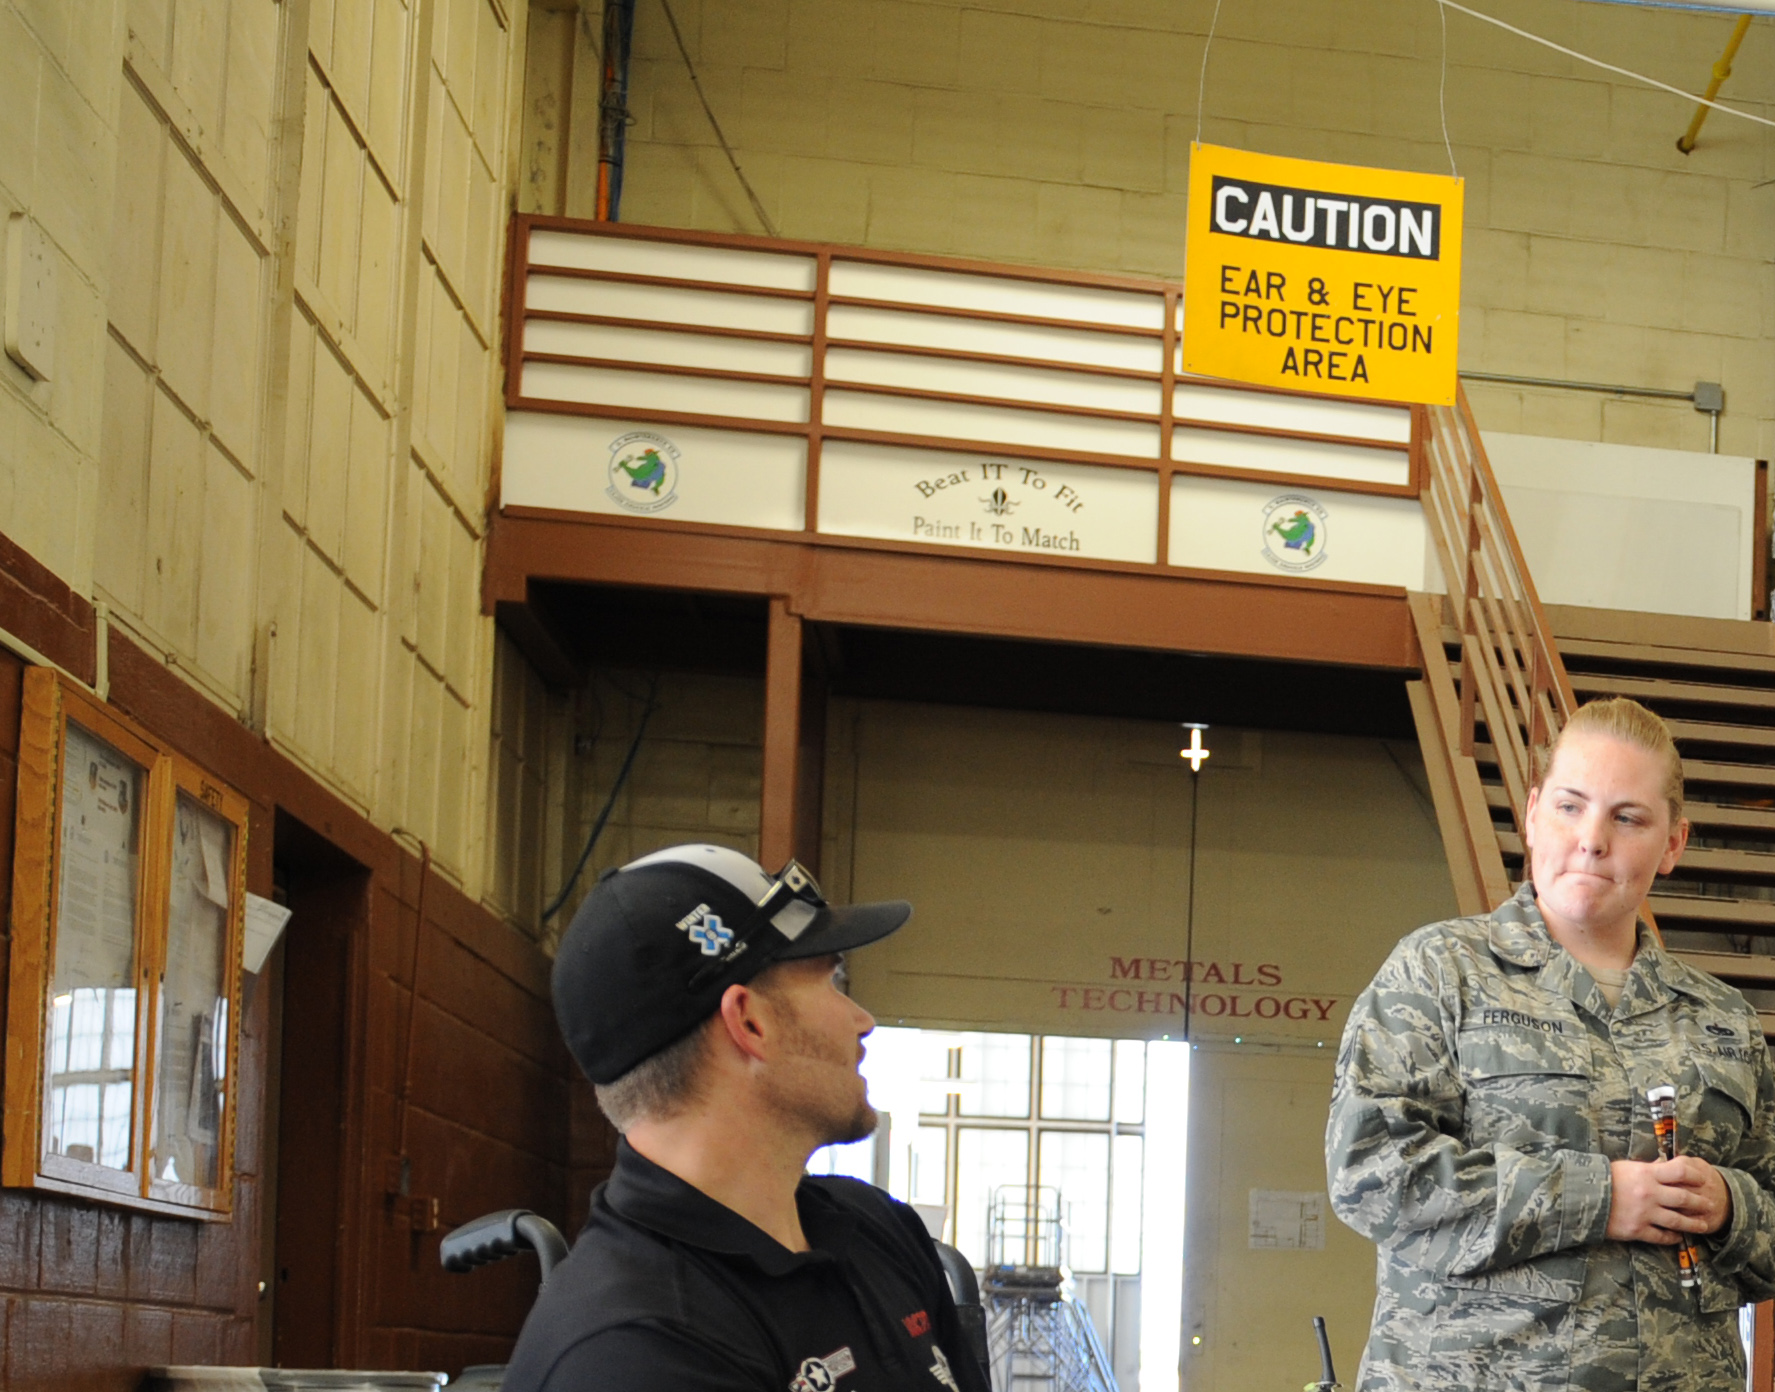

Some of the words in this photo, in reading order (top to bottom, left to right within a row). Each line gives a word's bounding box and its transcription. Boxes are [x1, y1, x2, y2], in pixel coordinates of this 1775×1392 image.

[1215, 185, 1433, 256] CAUTION
[1220, 265, 1286, 302] EAR
[1307, 277, 1330, 306] &
[1353, 282, 1418, 317] EYE
[1219, 300, 1433, 354] PROTECTION
[1280, 346, 1369, 384] AREA
[914, 469, 970, 499] Beat
[980, 463, 1009, 480] IT
[1019, 467, 1047, 490] To
[1053, 484, 1085, 514] Fit
[912, 516, 961, 539] Paint
[970, 521, 983, 541] It
[991, 523, 1014, 544] To
[1021, 526, 1080, 551] Match
[1108, 956, 1283, 986] METALS
[1051, 986, 1338, 1021] TECHNOLOGY
[1483, 1009, 1563, 1033] FERGUSON
